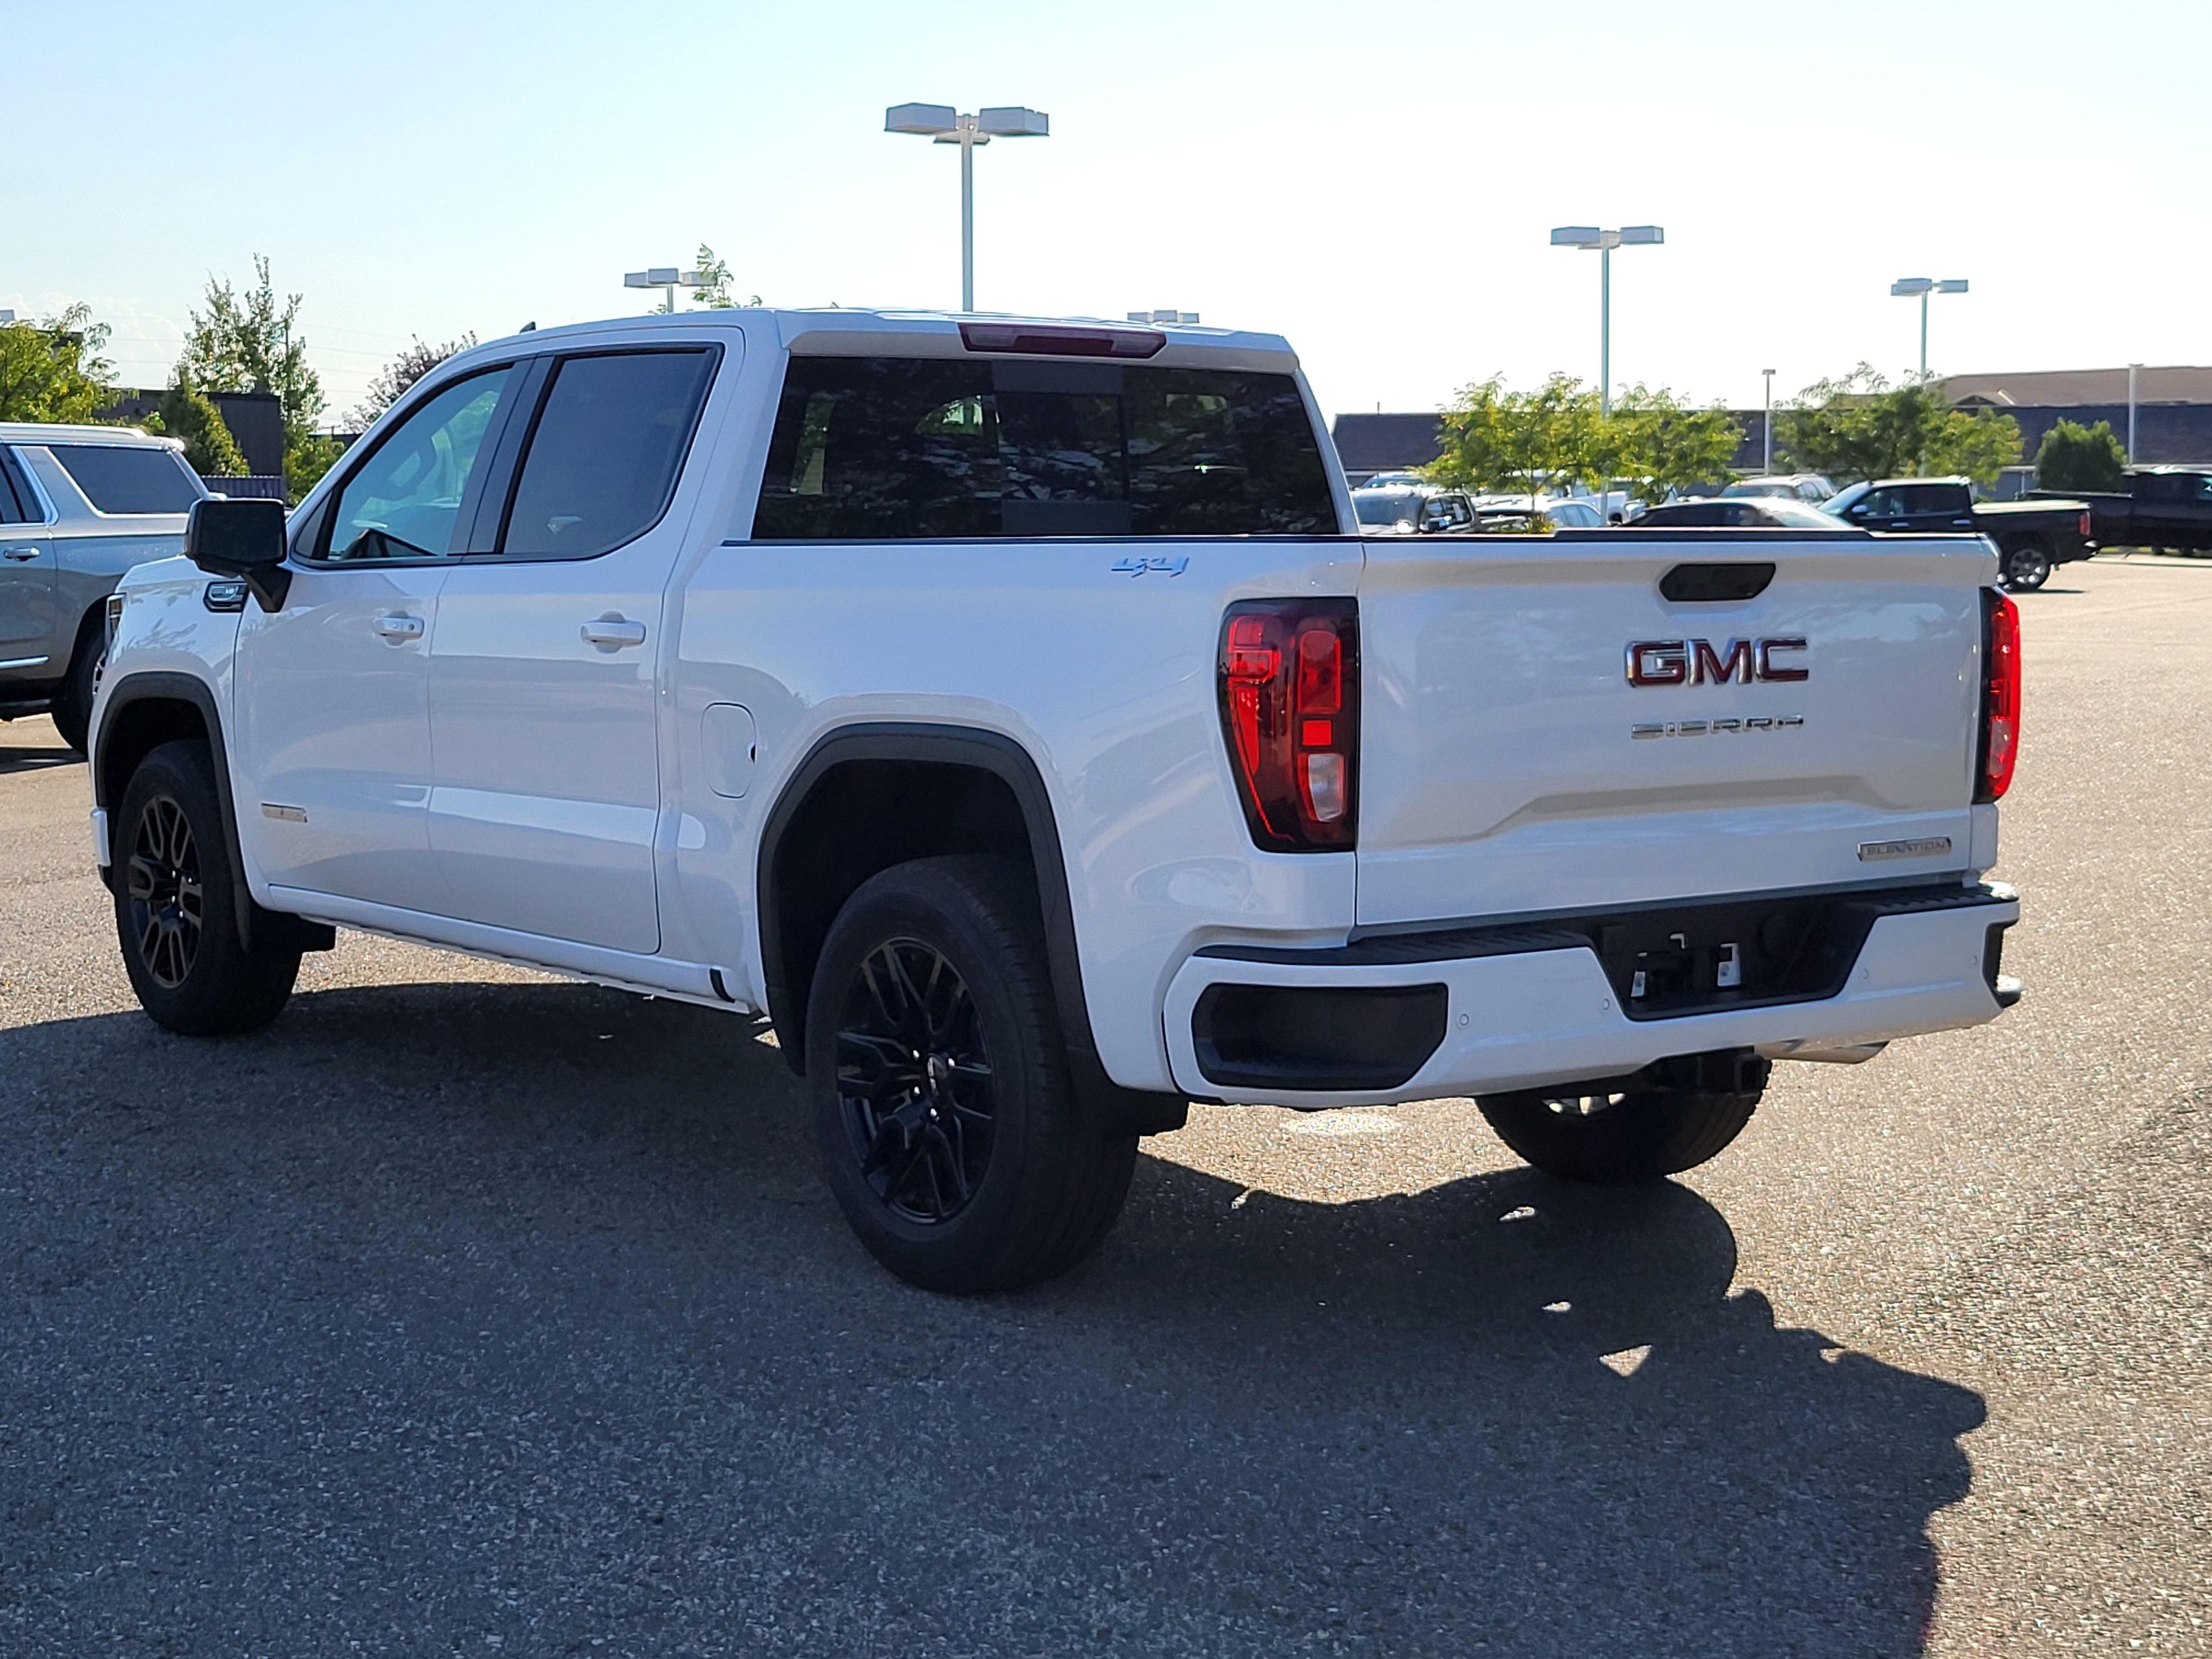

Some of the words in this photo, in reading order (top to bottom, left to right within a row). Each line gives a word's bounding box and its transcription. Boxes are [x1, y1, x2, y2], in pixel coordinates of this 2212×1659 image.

[1625, 637, 1808, 687] GMC
[1631, 714, 1804, 739] SIERRA
[1866, 841, 1945, 855] ELEVATION
